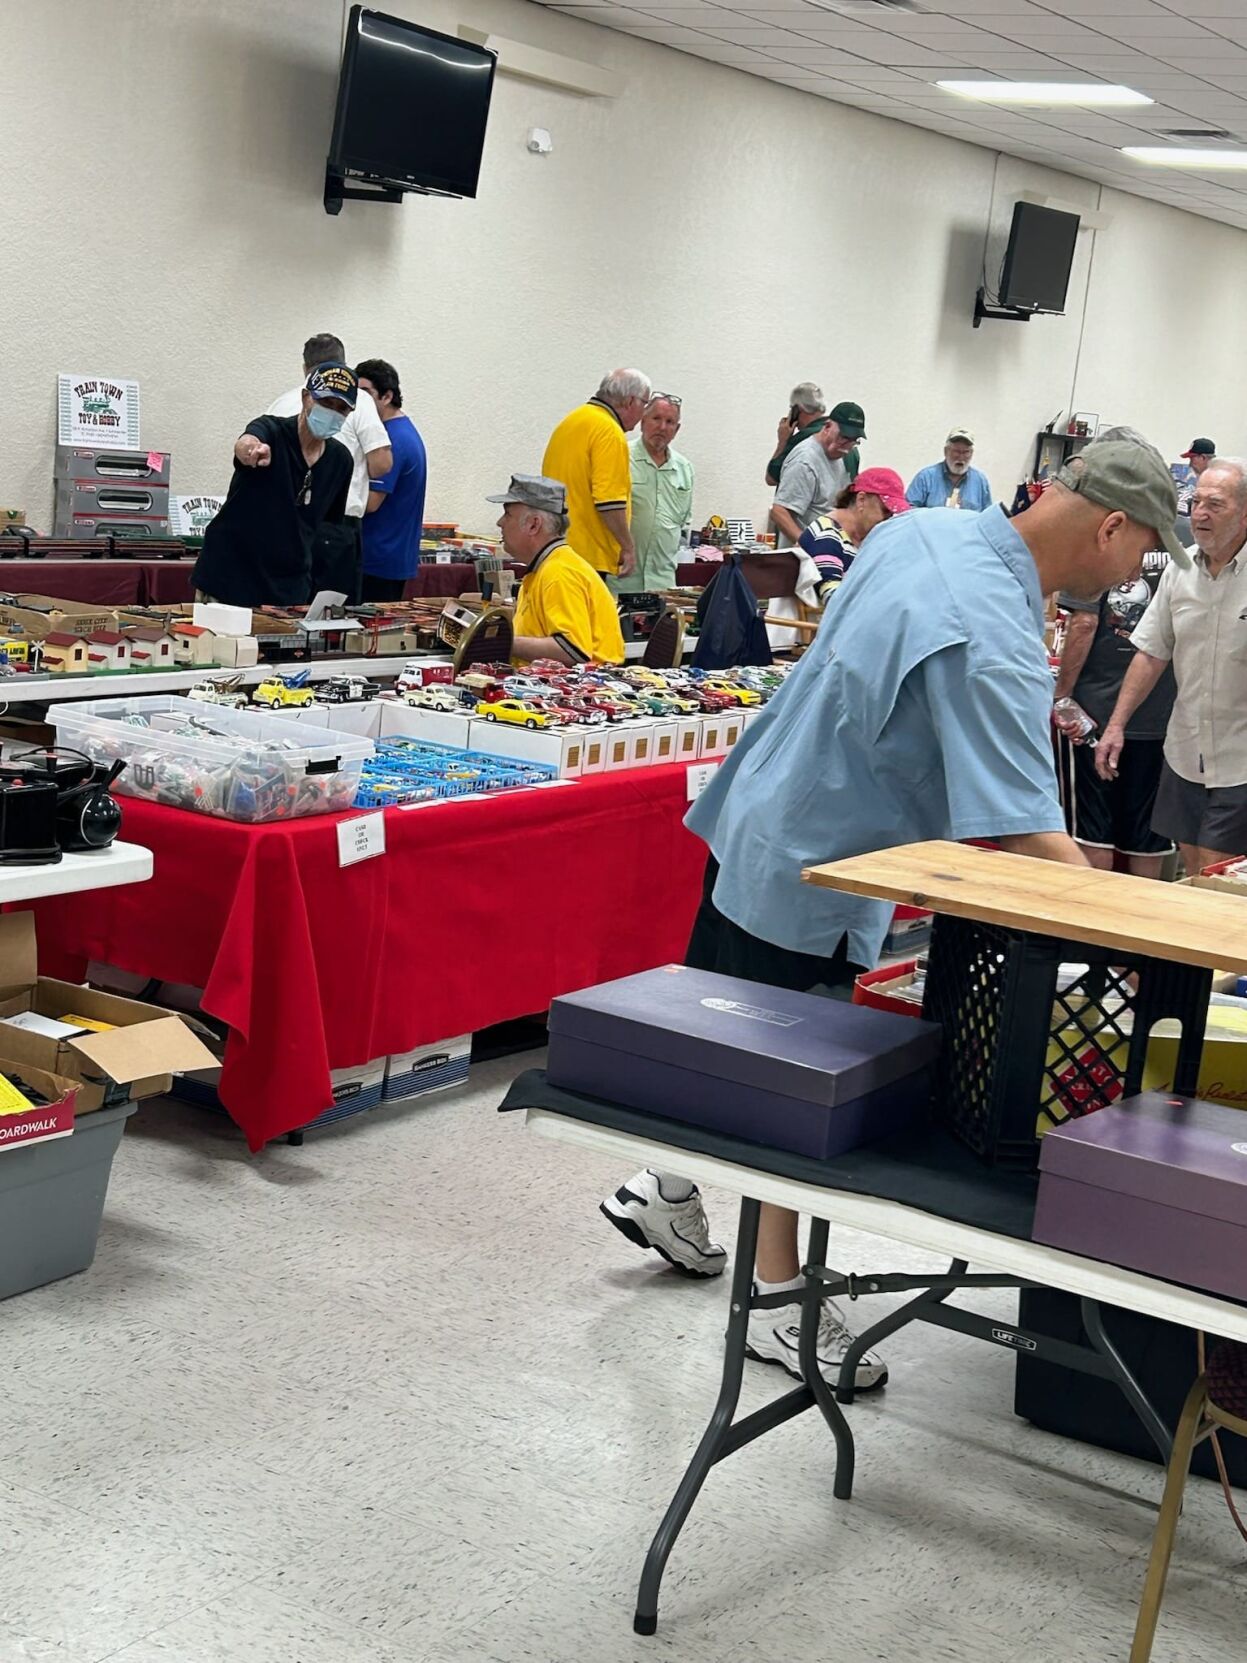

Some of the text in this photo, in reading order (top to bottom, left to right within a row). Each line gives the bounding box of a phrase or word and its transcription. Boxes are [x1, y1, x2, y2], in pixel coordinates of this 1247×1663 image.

[74, 381, 123, 400] TRAIN TOWN
[78, 413, 121, 427] TOY & HOBBY
[182, 498, 202, 514] TRAIN
[0, 1117, 57, 1140] OARDWALK
